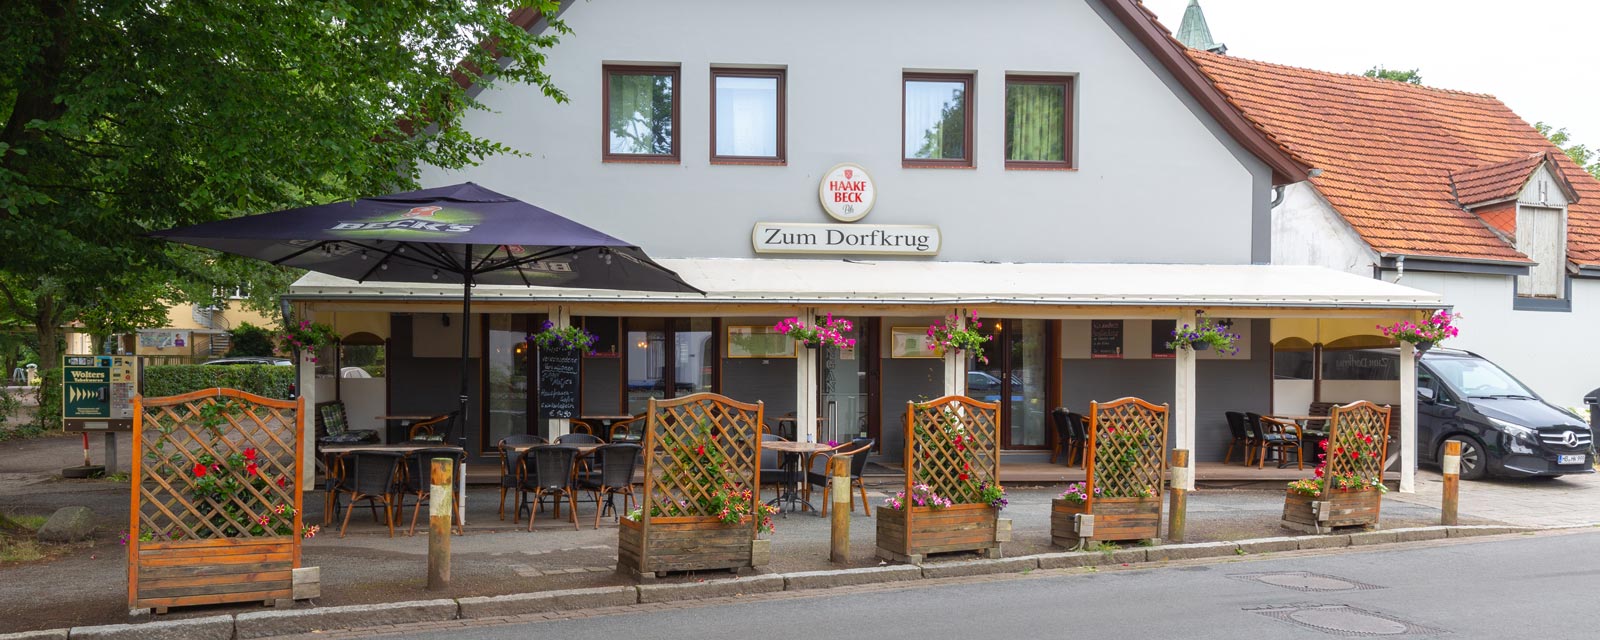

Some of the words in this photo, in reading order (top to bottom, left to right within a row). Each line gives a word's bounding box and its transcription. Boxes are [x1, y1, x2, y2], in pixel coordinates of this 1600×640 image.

[830, 181, 867, 191] HAAKE
[834, 192, 863, 202] BECK
[765, 228, 817, 245] Zum
[826, 229, 930, 251] Dorfkrug
[70, 370, 105, 379] Wolters
